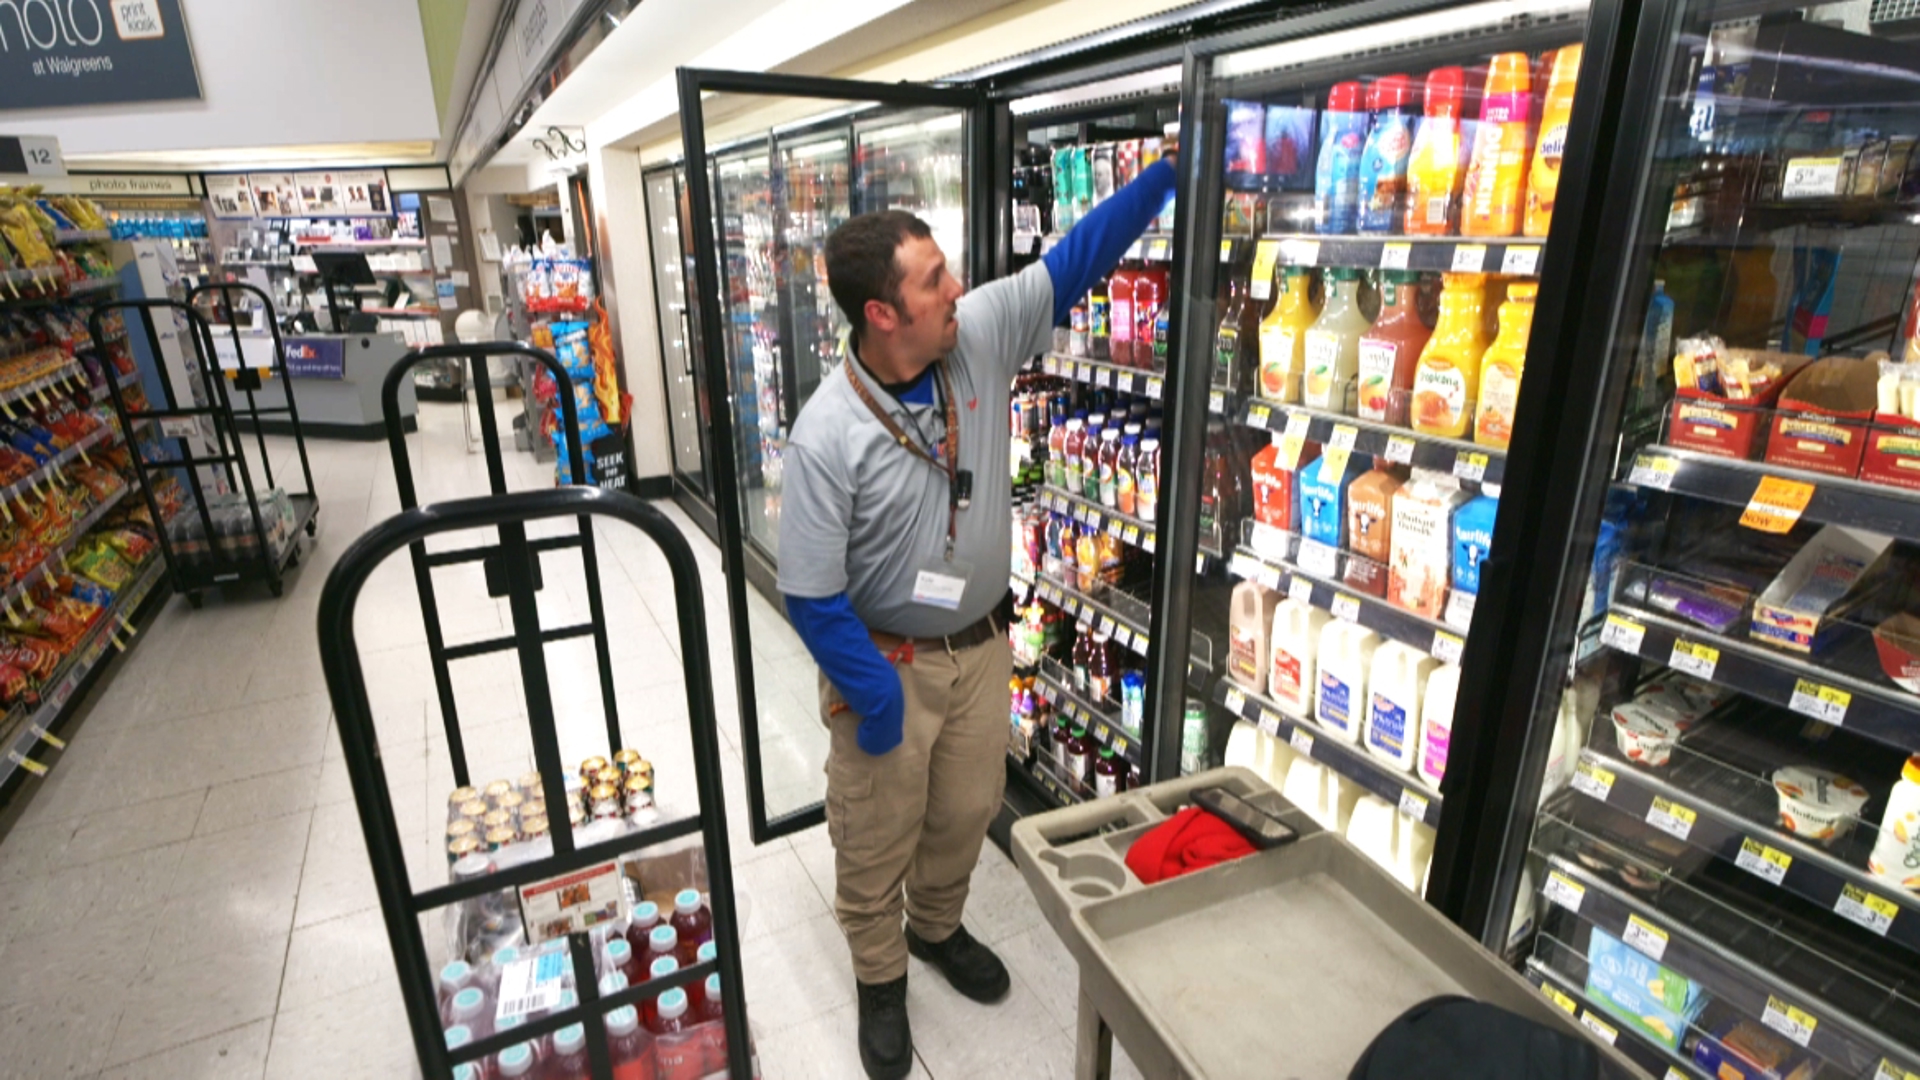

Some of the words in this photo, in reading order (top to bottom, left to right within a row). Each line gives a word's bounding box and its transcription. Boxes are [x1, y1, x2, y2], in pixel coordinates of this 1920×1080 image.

[120, 3, 146, 21] print
[127, 16, 157, 33] kiosk
[32, 61, 46, 76] at
[46, 55, 113, 76] Walgreens
[28, 149, 52, 164] 12
[90, 179, 127, 192] photo
[130, 178, 173, 191] frames
[285, 343, 317, 358] FedEx
[596, 451, 624, 469] SEEK
[600, 475, 626, 490] HEAT
[1743, 511, 1771, 527] NOW
